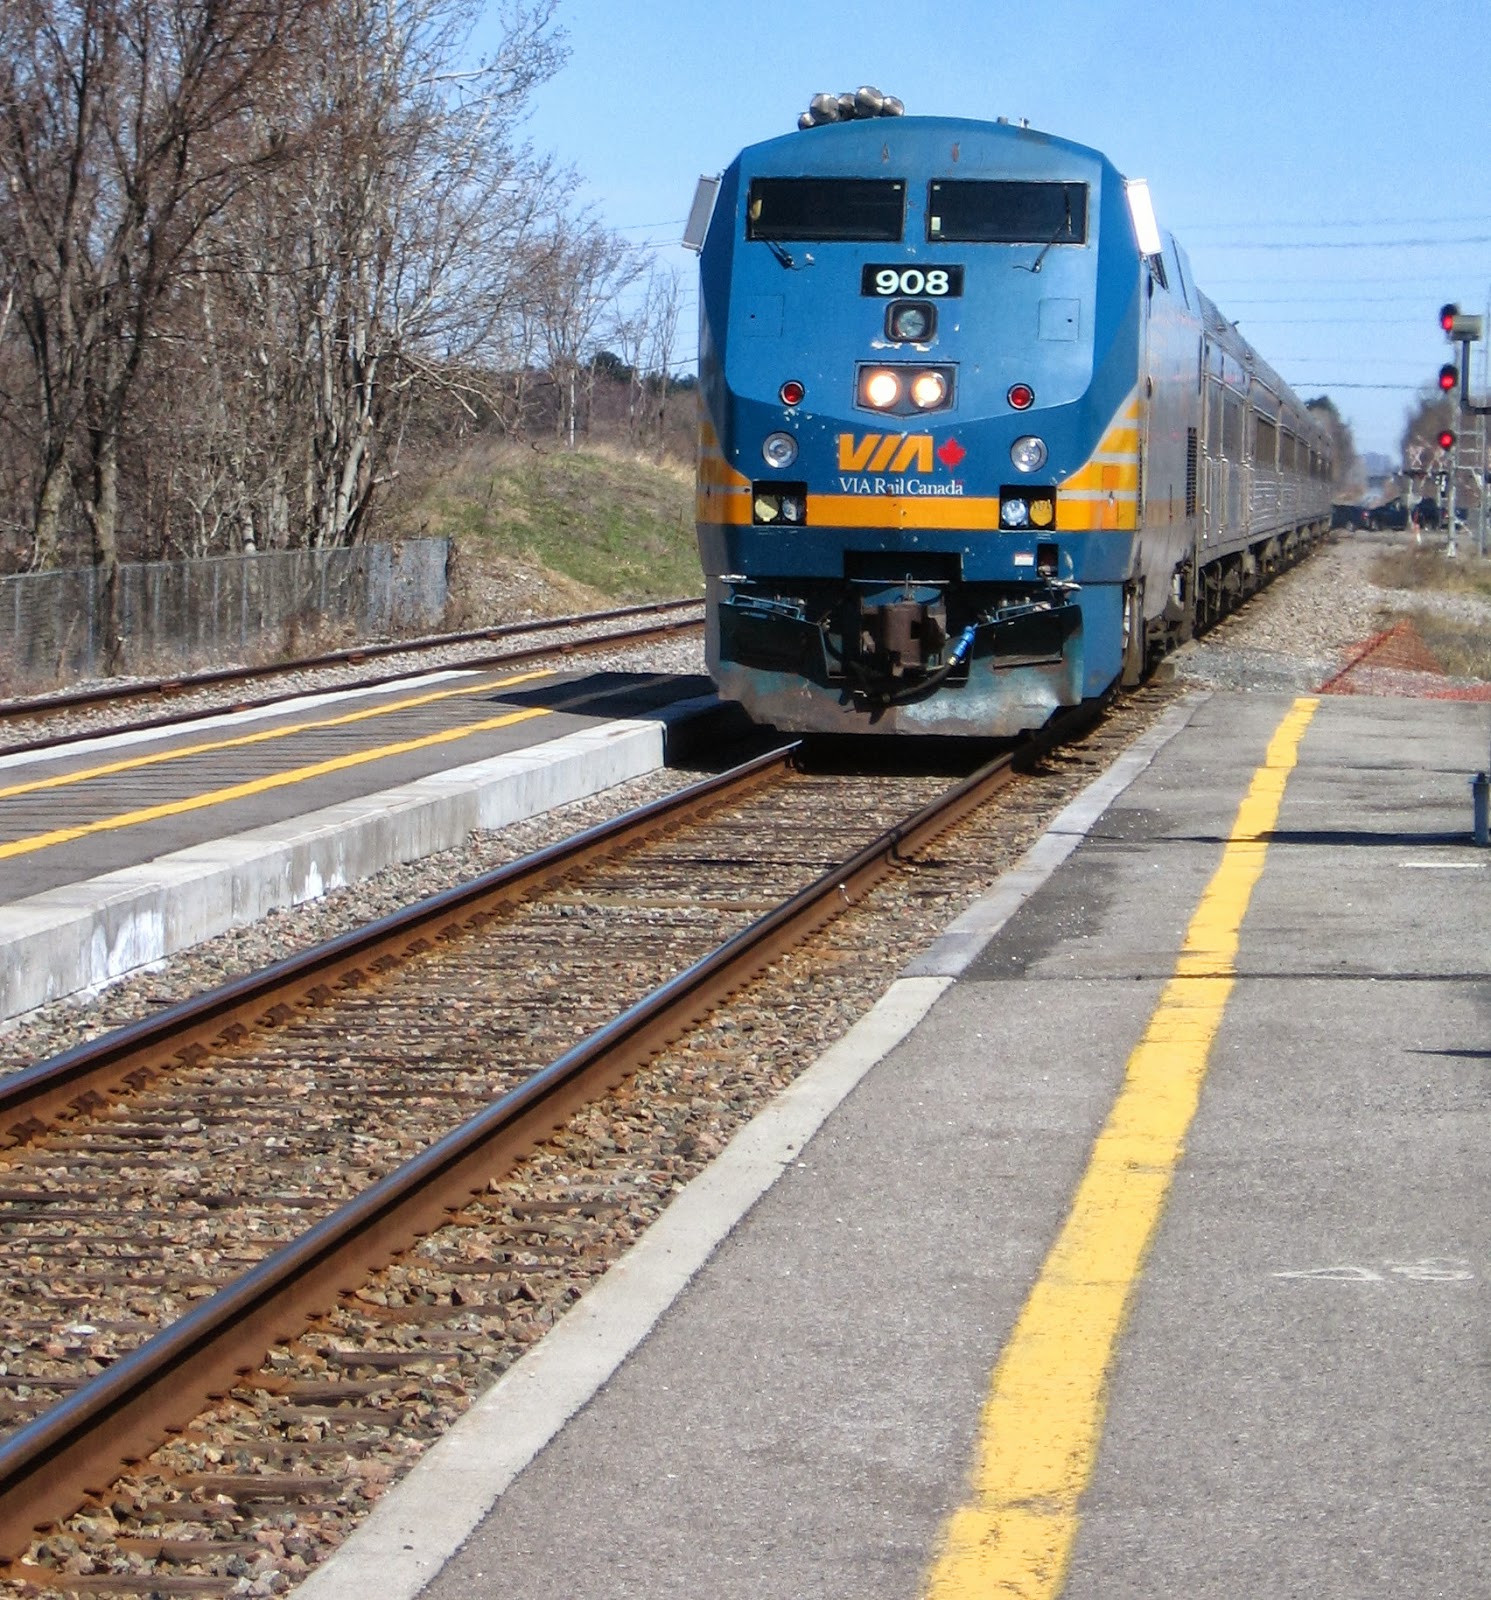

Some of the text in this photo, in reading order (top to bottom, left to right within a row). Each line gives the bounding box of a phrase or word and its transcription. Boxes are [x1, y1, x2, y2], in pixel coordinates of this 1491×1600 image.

[875, 269, 950, 295] 908
[838, 433, 934, 473] VIA
[839, 477, 964, 495] VIA Rail Canada
